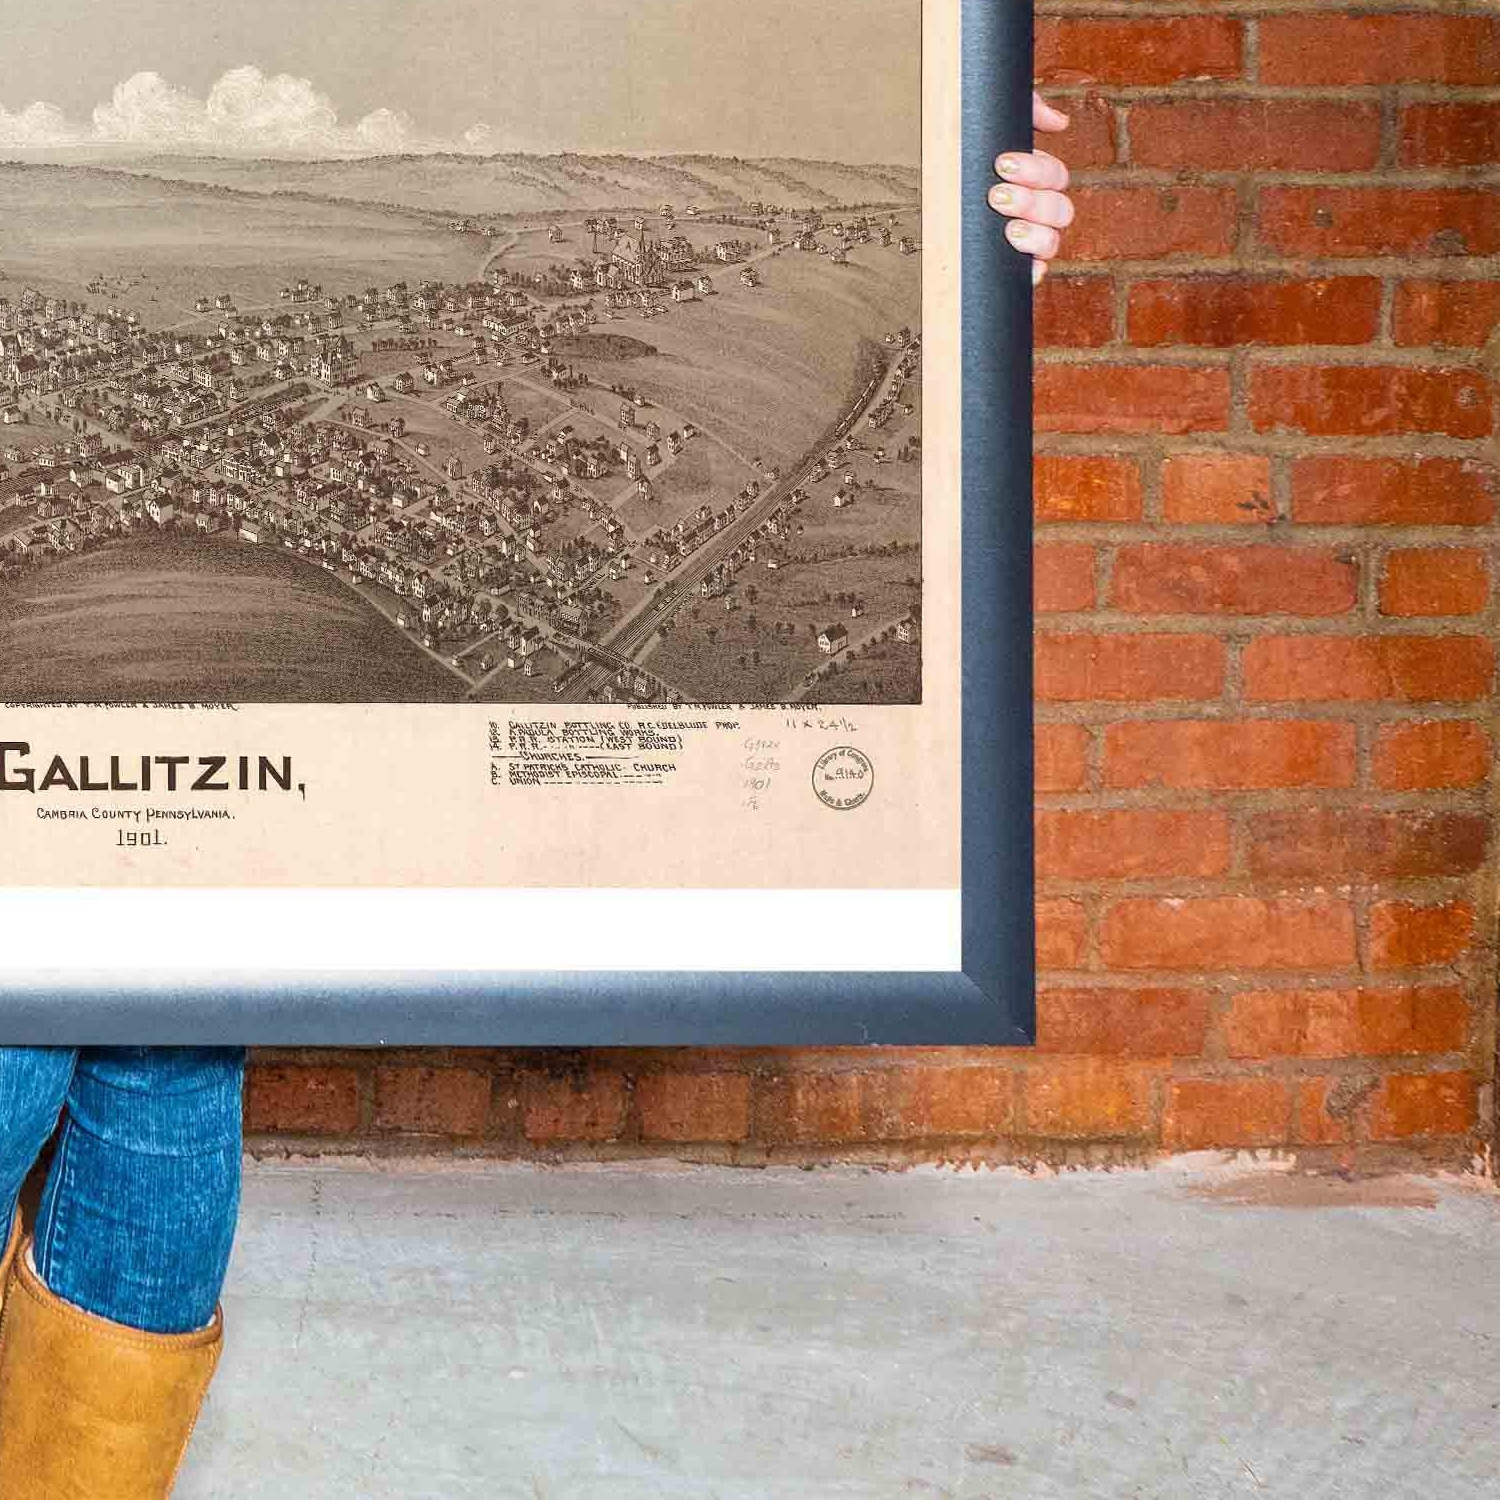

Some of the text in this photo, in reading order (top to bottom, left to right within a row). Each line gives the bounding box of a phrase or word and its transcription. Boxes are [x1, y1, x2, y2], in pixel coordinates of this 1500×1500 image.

[509, 720, 557, 729] GALLITZIN
[633, 763, 677, 772] CHURCH
[36, 807, 236, 823] CAMBRIA COUNTY PENNSYLVANIA.
[116, 829, 168, 846] 1901.
